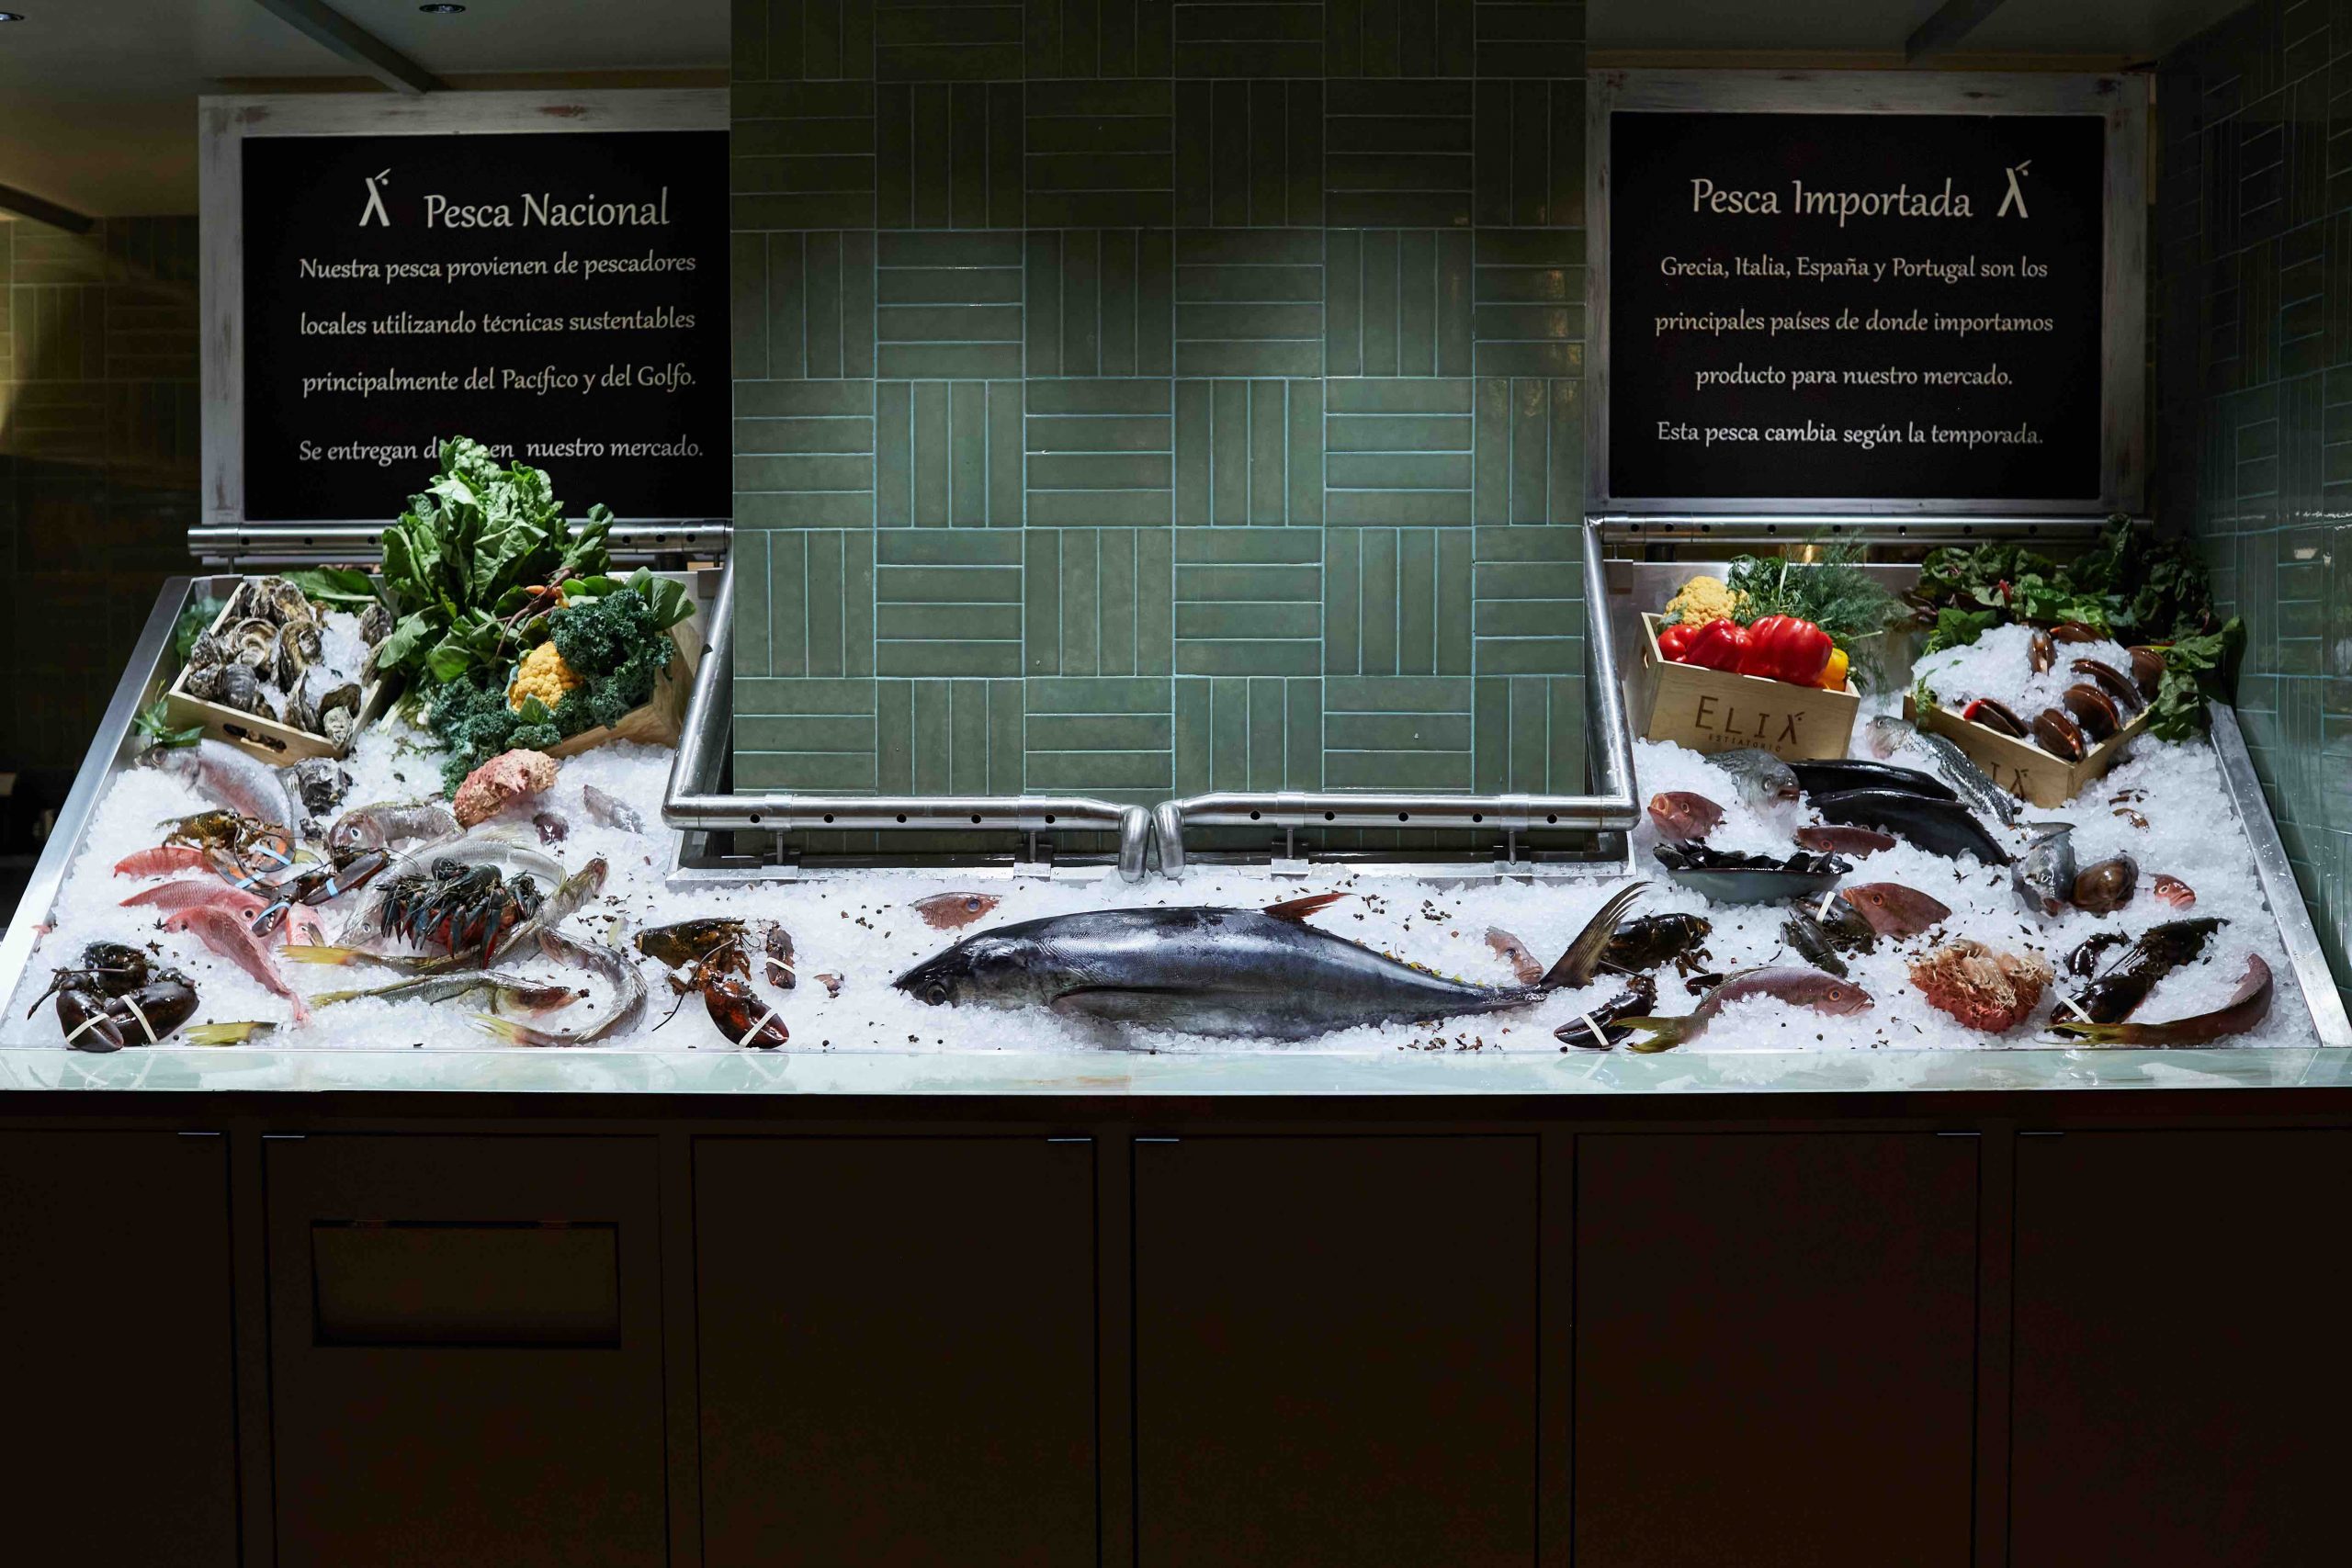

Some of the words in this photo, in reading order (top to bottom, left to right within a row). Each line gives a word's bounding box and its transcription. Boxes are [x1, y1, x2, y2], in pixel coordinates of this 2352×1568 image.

[424, 195, 514, 228] Pesca
[521, 186, 669, 226] Nacional
[1690, 179, 1781, 214] Pesca
[1792, 177, 1973, 228] Importada
[300, 259, 380, 278] Nuestra
[385, 264, 442, 284] pesca
[447, 257, 548, 283] provienen
[554, 251, 578, 274] de
[584, 249, 695, 279] pescadores
[1661, 256, 1729, 278] Grecia,
[1735, 254, 1791, 278] Italia,
[1797, 257, 1870, 282] España
[1873, 264, 1885, 282] y
[1893, 255, 1975, 284] Portugal
[1981, 265, 2015, 276] son
[2022, 255, 2047, 276] los
[301, 311, 367, 334] locales
[372, 310, 476, 334] utilizando
[482, 313, 563, 333] técnicas
[570, 306, 695, 330] sustentables
[1655, 309, 1764, 336] principales
[1770, 311, 1829, 336] países
[1836, 309, 1859, 330] de
[1866, 309, 1928, 331] donde
[1935, 313, 2052, 337] importamos
[302, 367, 458, 398] principalmente
[464, 367, 494, 389] del
[502, 366, 578, 395] Pacífico
[582, 374, 595, 394] y
[601, 364, 631, 387] del
[638, 363, 695, 392] Golfo.
[1695, 362, 1785, 390] producto
[1792, 371, 1838, 390] para
[1843, 367, 1917, 384] nuestro
[1924, 364, 2012, 385] mercado.
[1657, 422, 1700, 440] Esta
[1704, 428, 1759, 447] pesca
[1765, 420, 1838, 441] cambia
[1843, 423, 1902, 449] según
[1908, 422, 1926, 443] la
[1931, 423, 2043, 449] temporada.
[300, 441, 322, 460] Se
[328, 441, 418, 467] entregan
[526, 438, 604, 457] nuestro
[610, 434, 702, 456] mercado.
